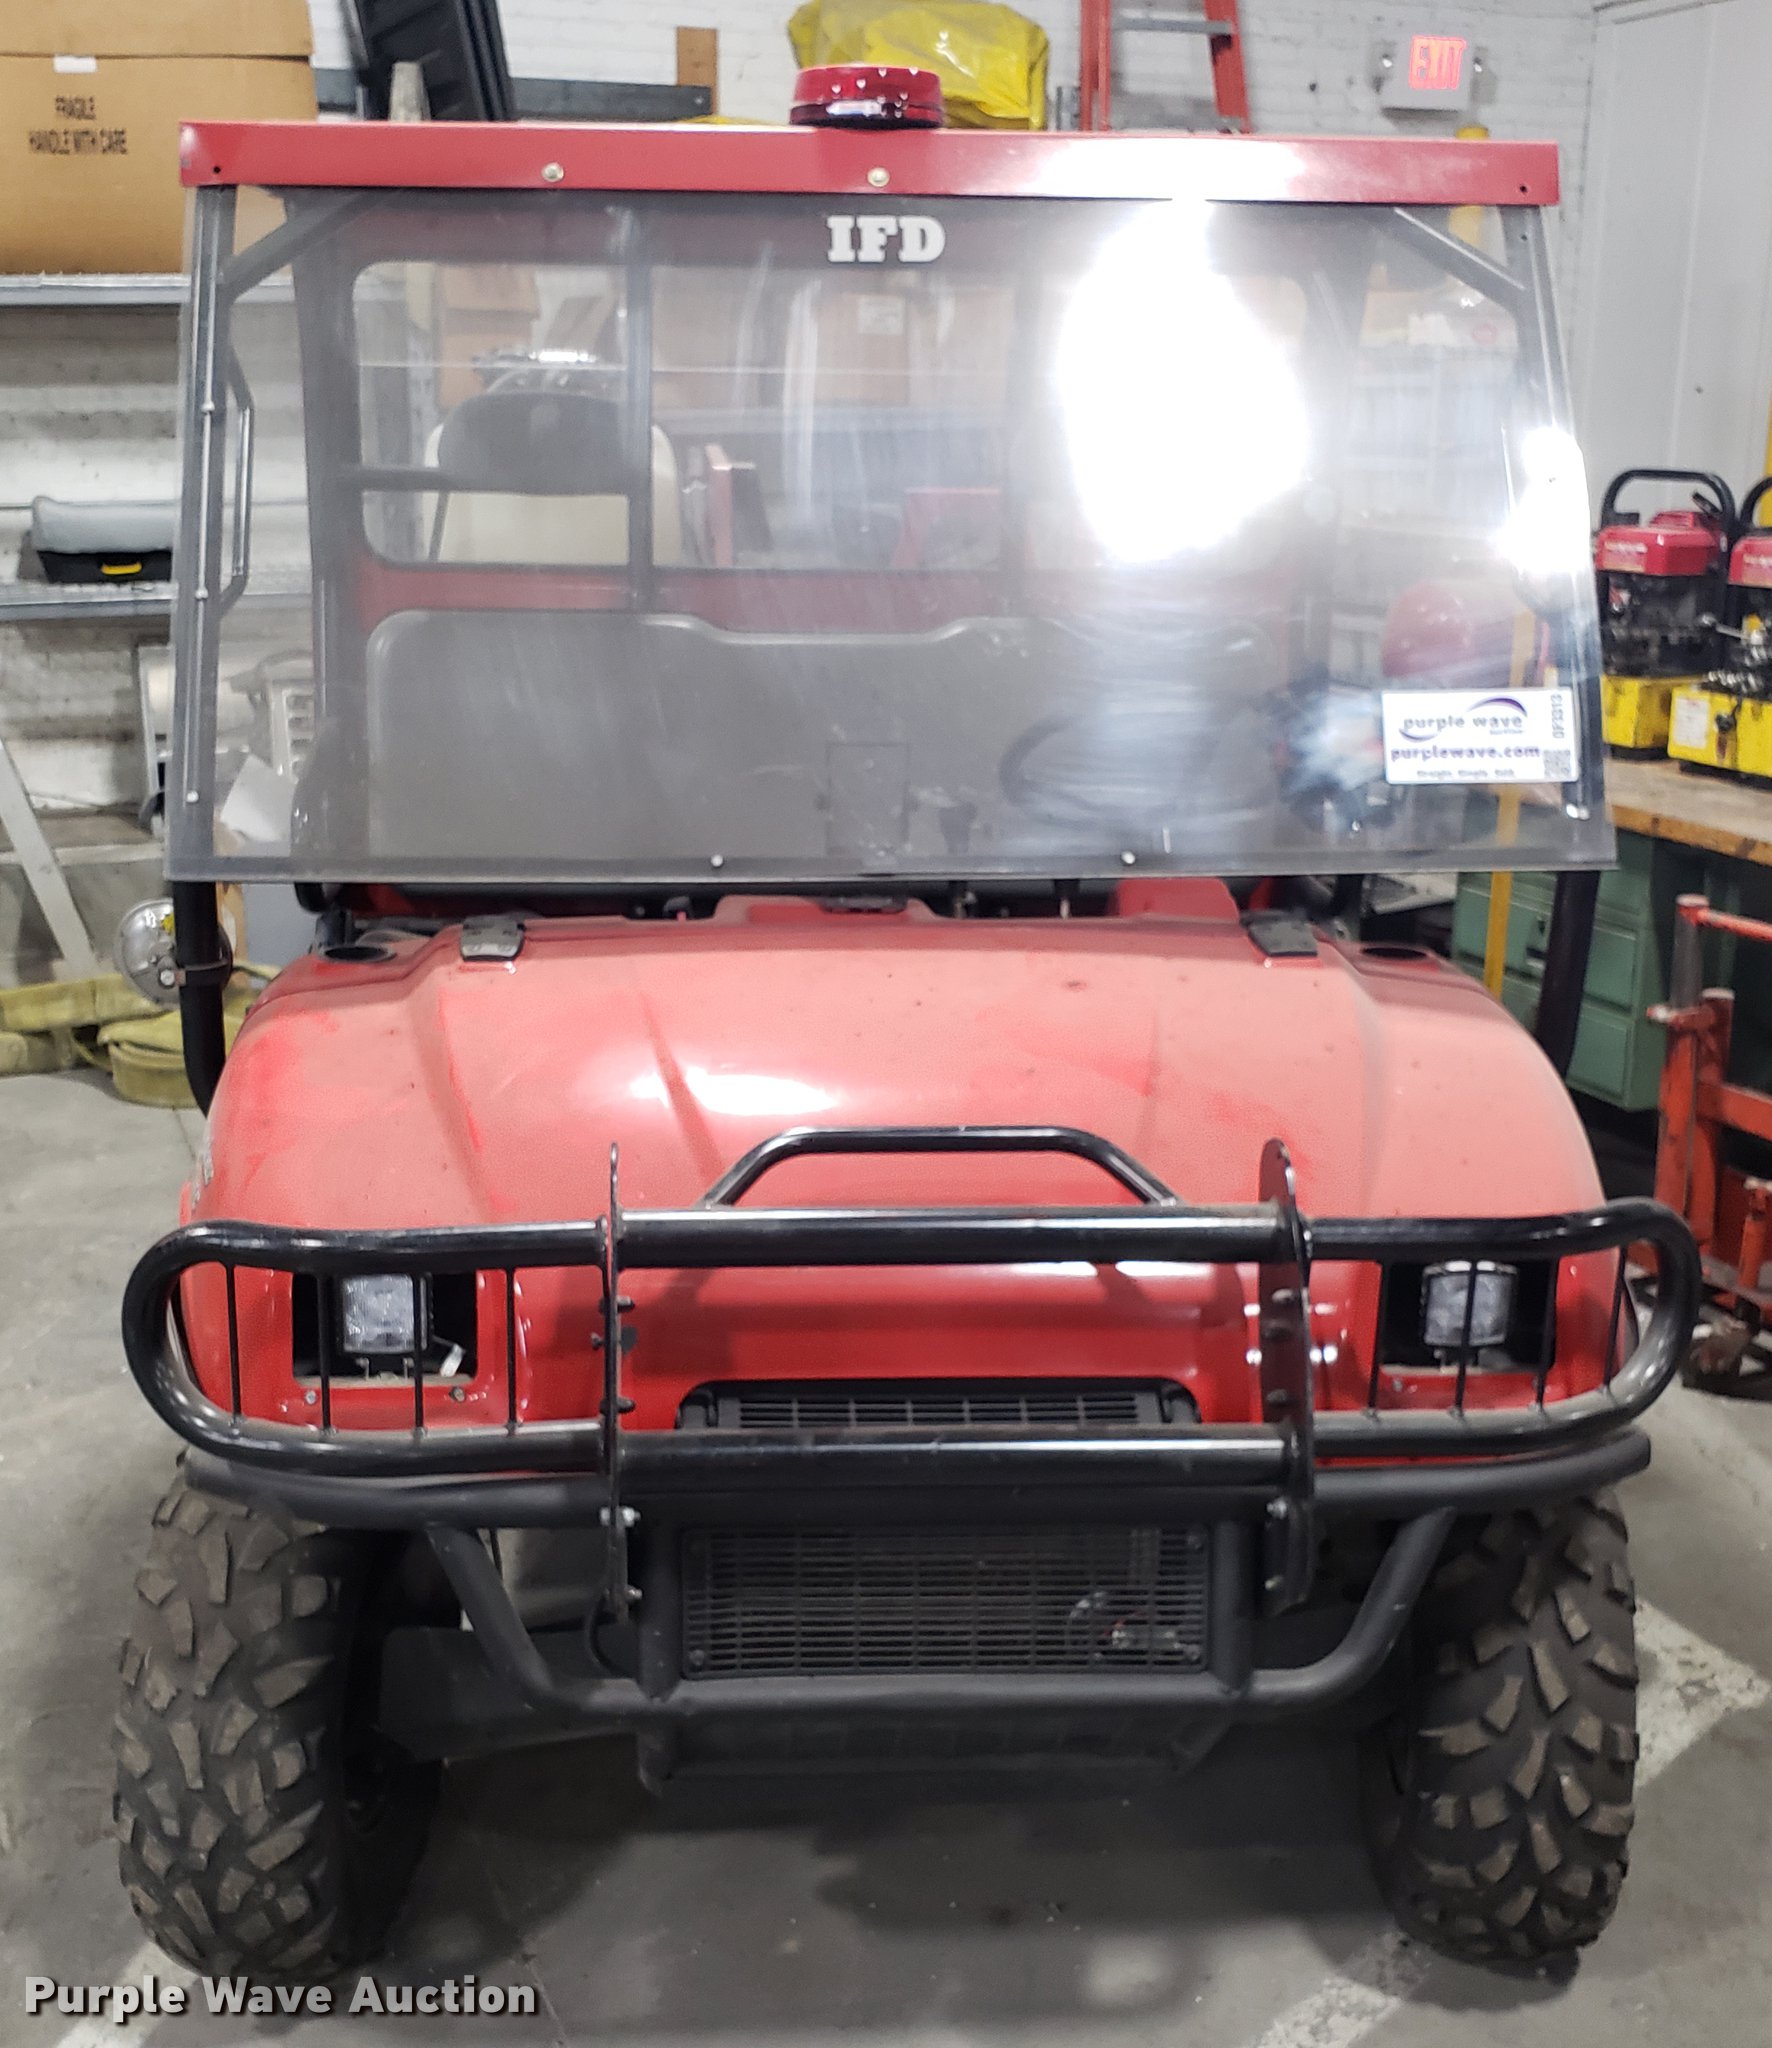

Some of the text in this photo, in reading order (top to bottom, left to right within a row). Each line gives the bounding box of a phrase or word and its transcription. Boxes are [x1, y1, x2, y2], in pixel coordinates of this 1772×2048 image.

[1408, 35, 1467, 90] EXIT
[55, 97, 97, 120] FRAGILE
[29, 129, 129, 154] HANDLE WITH CARE
[827, 215, 946, 263] IFD
[1403, 715, 1523, 732] purple wave
[1390, 745, 1541, 762] purplewave.com
